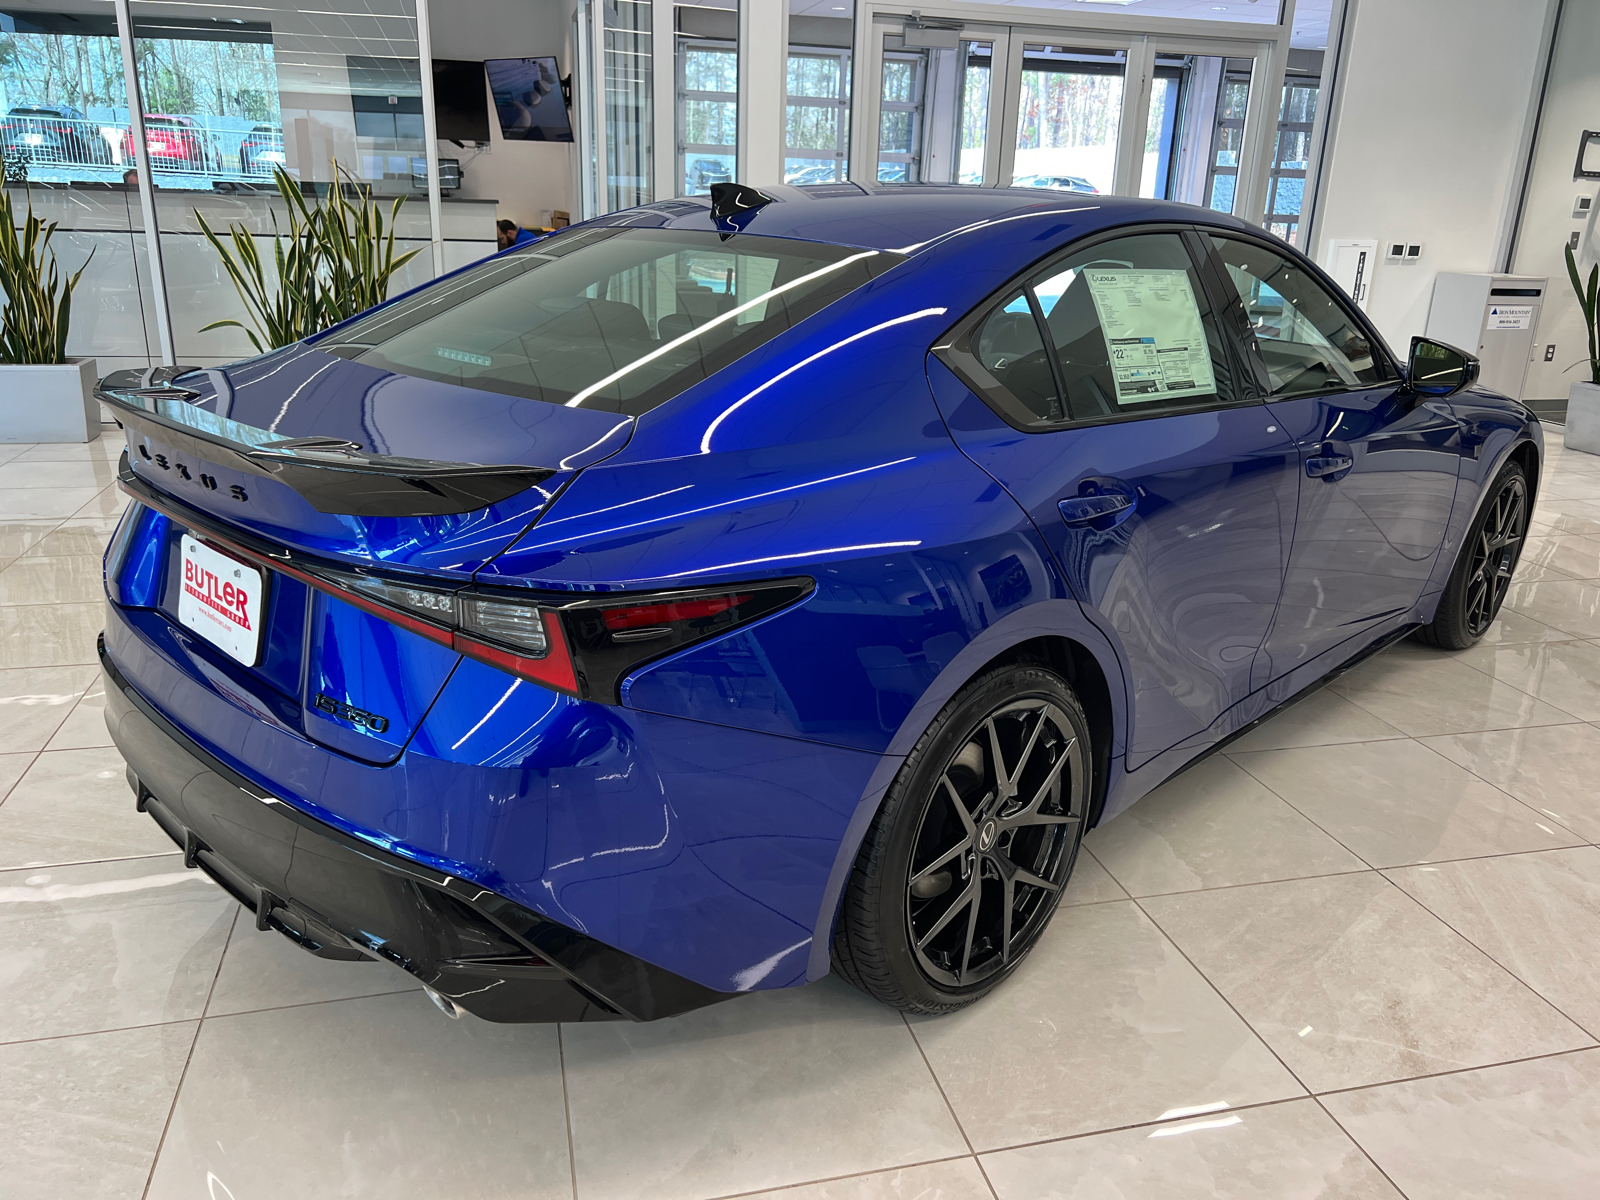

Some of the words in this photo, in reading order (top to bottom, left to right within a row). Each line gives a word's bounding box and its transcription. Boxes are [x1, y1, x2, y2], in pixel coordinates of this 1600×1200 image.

[1115, 349, 1125, 359] 22
[226, 610, 249, 629] GROUP
[314, 692, 340, 714] IS
[336, 702, 390, 734] 350
